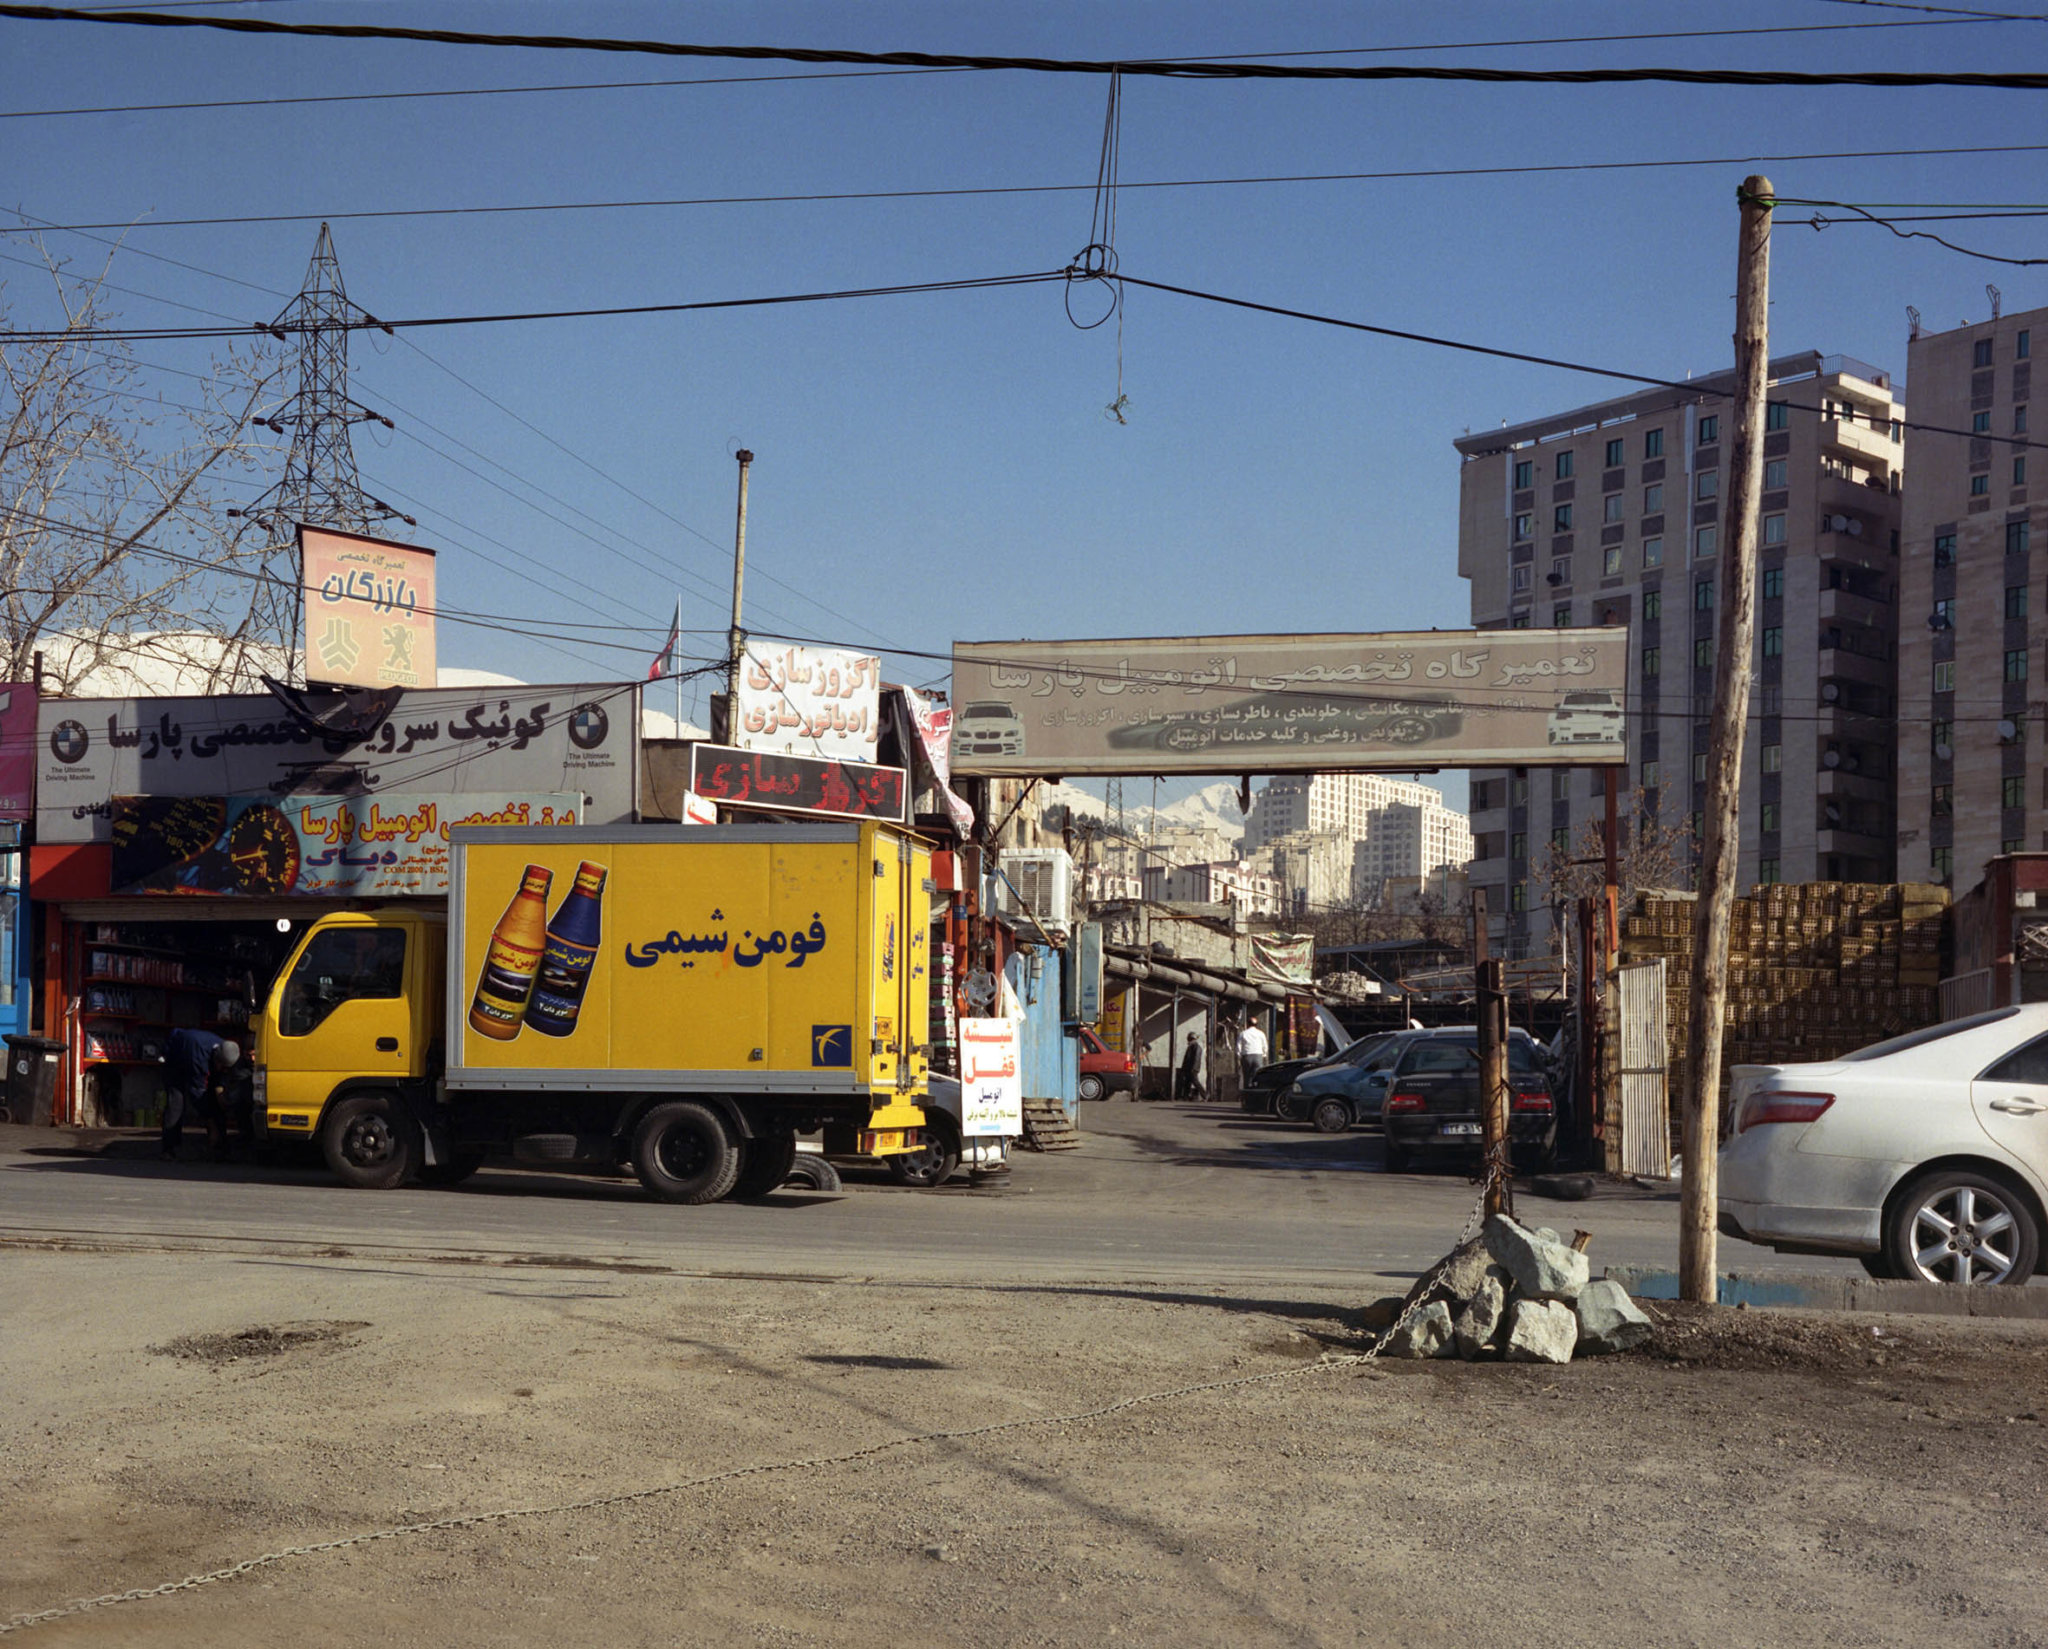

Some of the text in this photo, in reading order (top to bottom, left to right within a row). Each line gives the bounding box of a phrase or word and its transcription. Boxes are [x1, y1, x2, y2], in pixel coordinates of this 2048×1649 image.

[321, 569, 416, 618] بازرگان
[988, 657, 1085, 698] پارسا
[1096, 656, 1238, 695] اتومبیل
[1249, 652, 1414, 692] تخصصی
[108, 713, 183, 761] پارسا
[563, 761, 587, 769] Driving
[301, 804, 356, 845] پارسا
[359, 802, 437, 843] اتومبیل
[383, 866, 406, 874] COM
[625, 907, 728, 968] شیمی
[733, 911, 826, 968] فومن
[963, 1021, 1013, 1049] شیشه
[964, 1055, 1015, 1085] قفل
